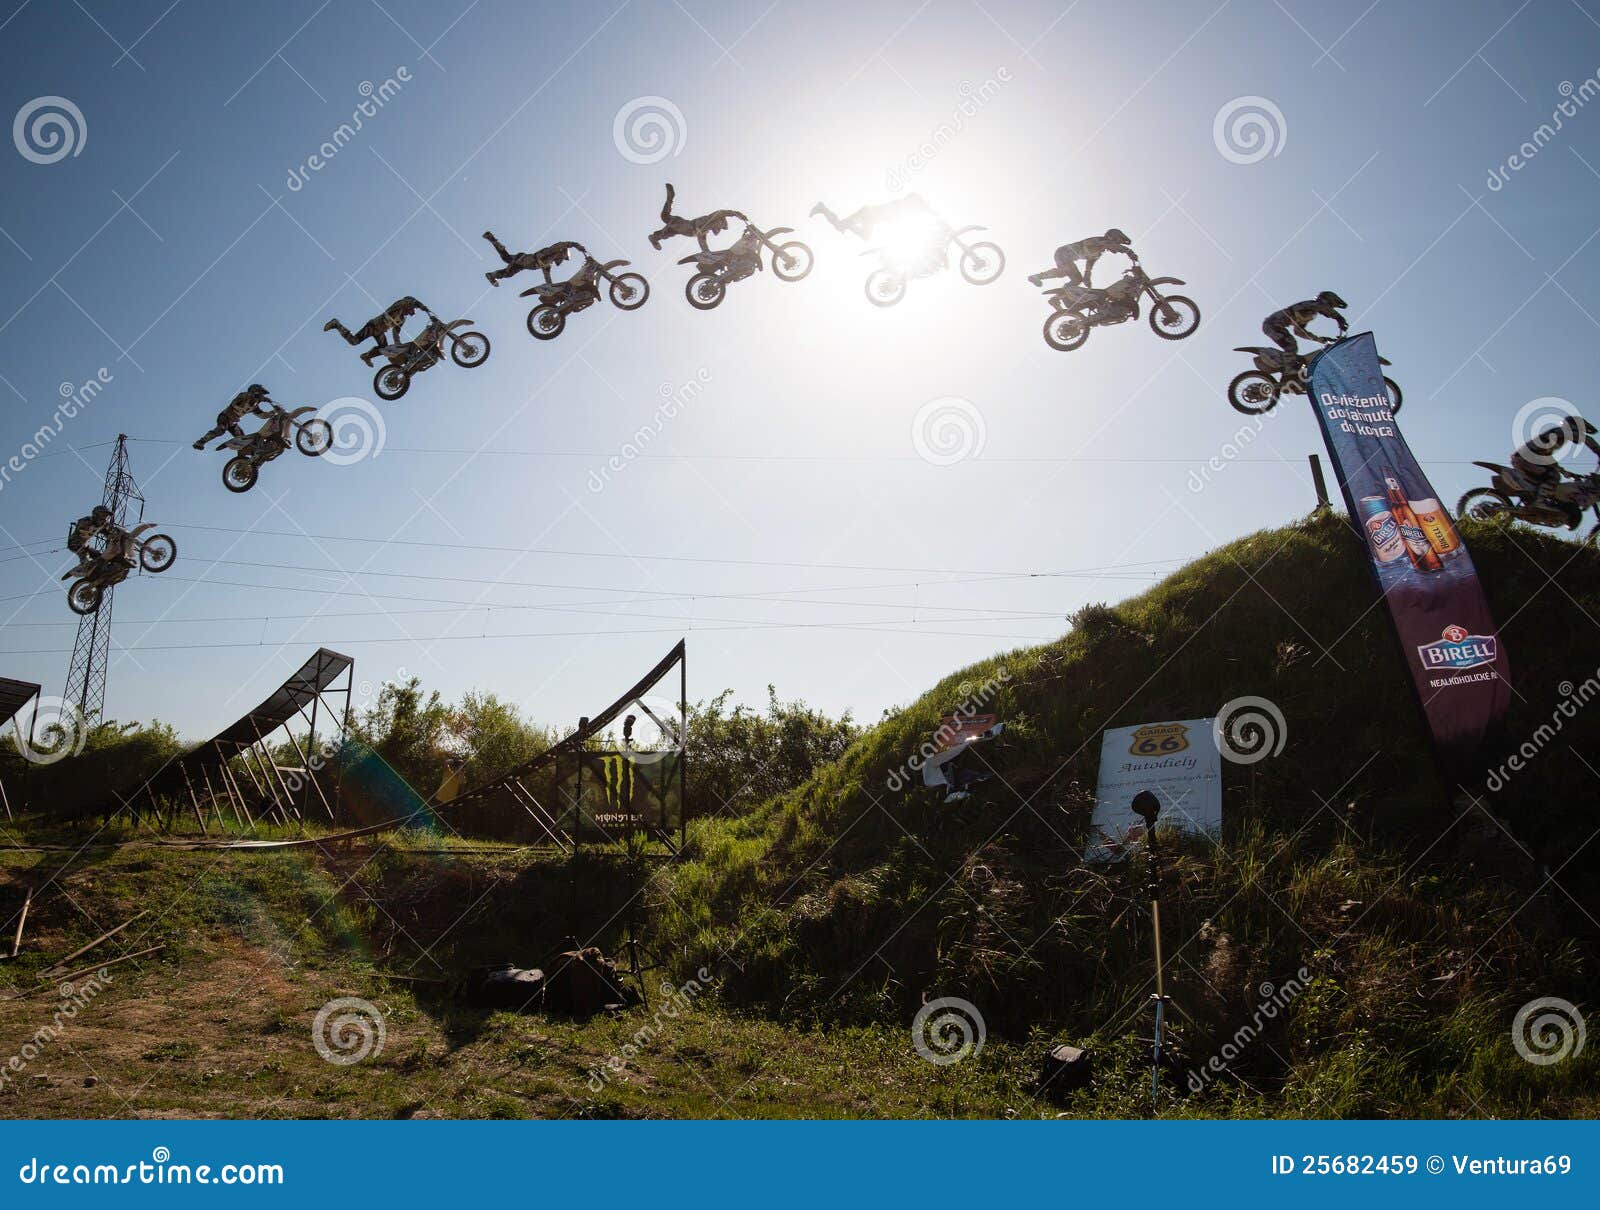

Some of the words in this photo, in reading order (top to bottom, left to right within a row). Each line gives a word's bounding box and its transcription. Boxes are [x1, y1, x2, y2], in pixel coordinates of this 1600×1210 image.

[1451, 628, 1463, 641] B
[1427, 643, 1495, 664] BIRELL
[1430, 672, 1491, 688] NEALKOHOLICKÉ
[1139, 736, 1179, 753] 66
[1119, 756, 1197, 774] Autodiely
